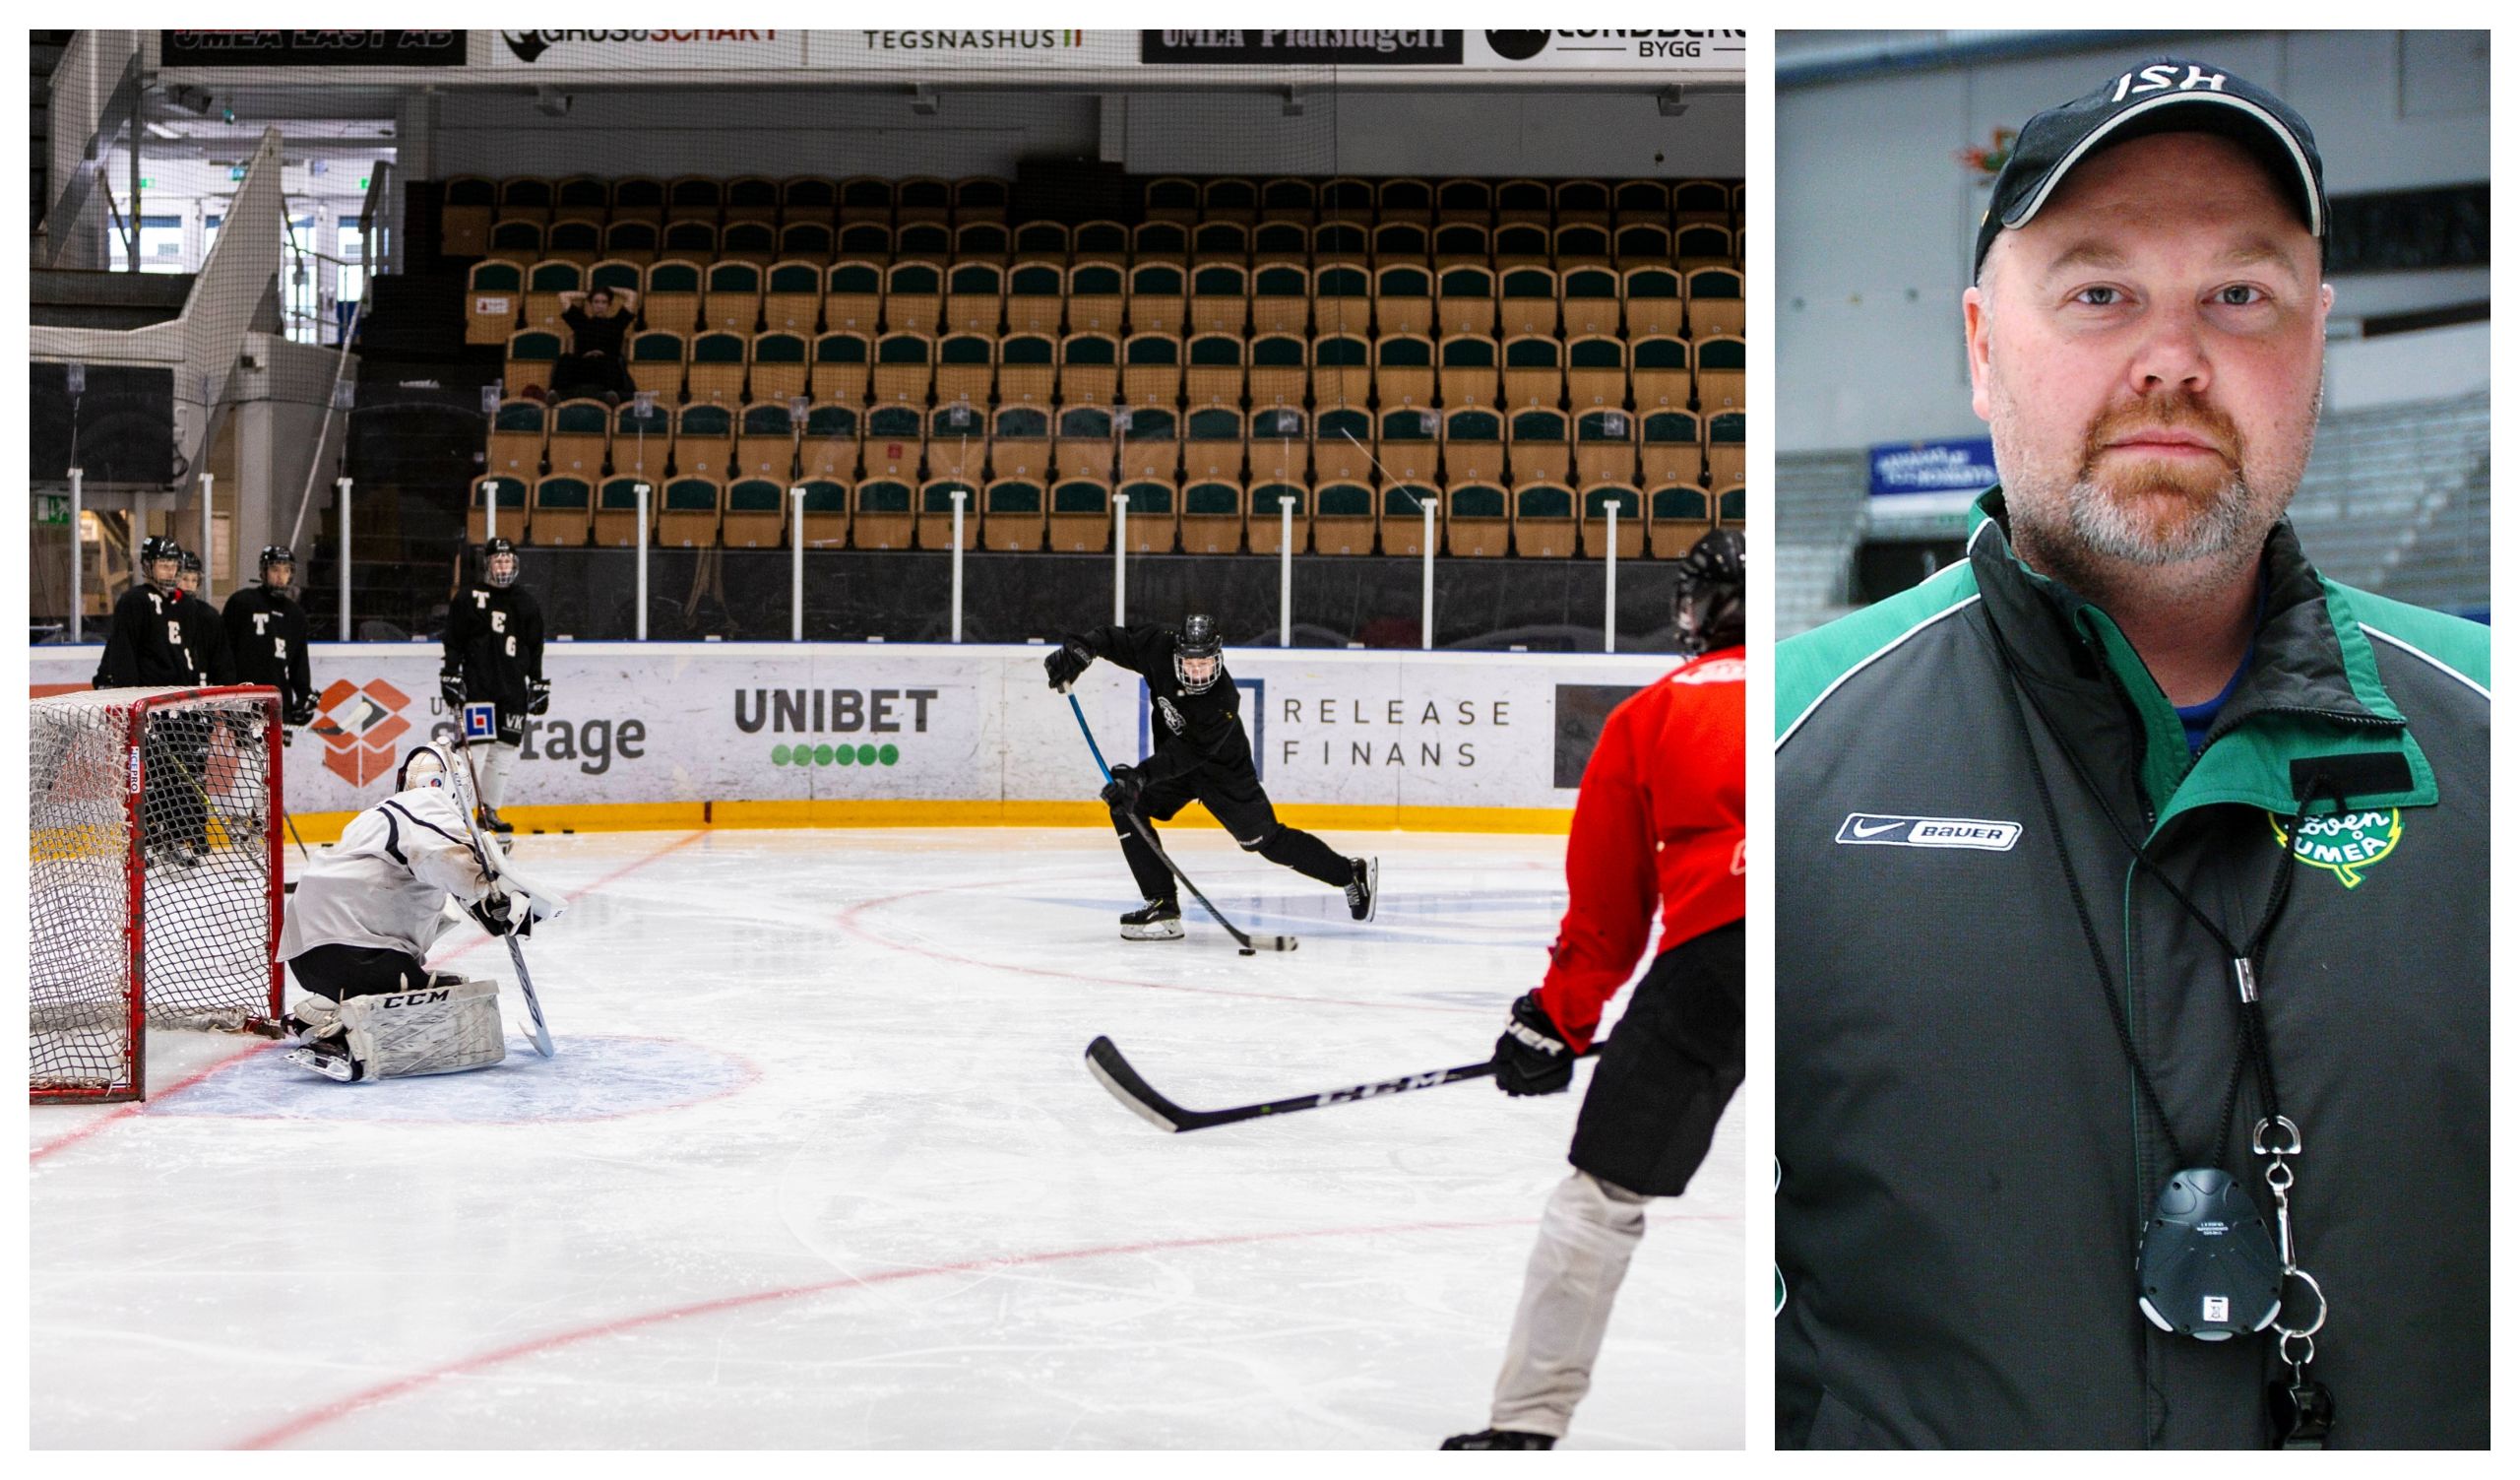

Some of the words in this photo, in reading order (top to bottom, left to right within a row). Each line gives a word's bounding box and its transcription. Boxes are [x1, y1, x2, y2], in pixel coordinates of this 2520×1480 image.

[863, 31, 1054, 48] TEGSNASHUS
[1639, 41, 1700, 57] BYGG
[2111, 65, 2226, 102] ISH
[735, 689, 938, 733] UNIBET
[1284, 699, 1511, 726] RELEASE
[1284, 740, 1476, 767] FINANS
[2296, 811, 2390, 836] öven
[2295, 830, 2387, 863] UMEÅ
[384, 990, 450, 1009] CCM
[1316, 1069, 1449, 1107] CCM
